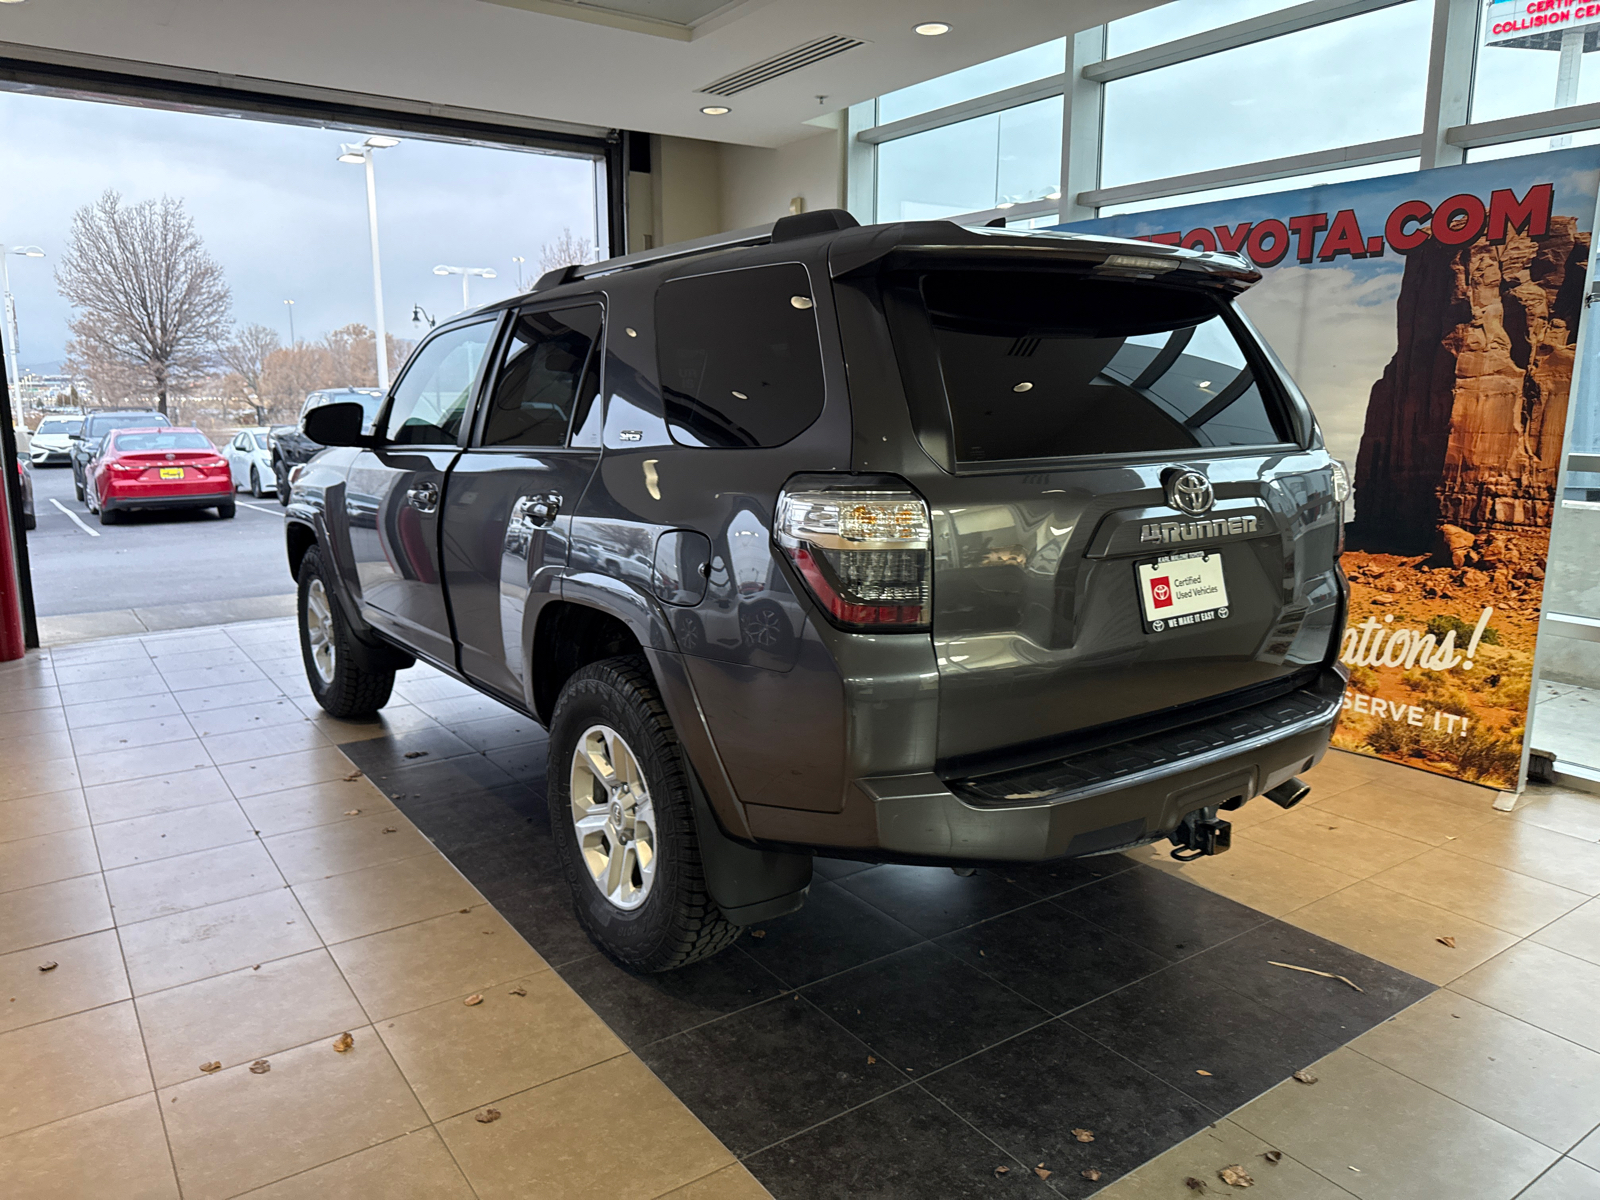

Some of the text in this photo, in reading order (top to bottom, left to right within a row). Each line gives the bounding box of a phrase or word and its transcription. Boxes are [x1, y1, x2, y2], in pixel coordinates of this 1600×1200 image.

[1526, 0, 1592, 14] CERTIF
[1492, 9, 1570, 35] COLLISION
[1128, 183, 1554, 268] YOTA.COM
[1174, 575, 1202, 588] Certified
[1175, 585, 1218, 600] Used Vehicles
[1168, 611, 1215, 628] WE MAKE IT EASY
[1433, 711, 1469, 737] IT!
